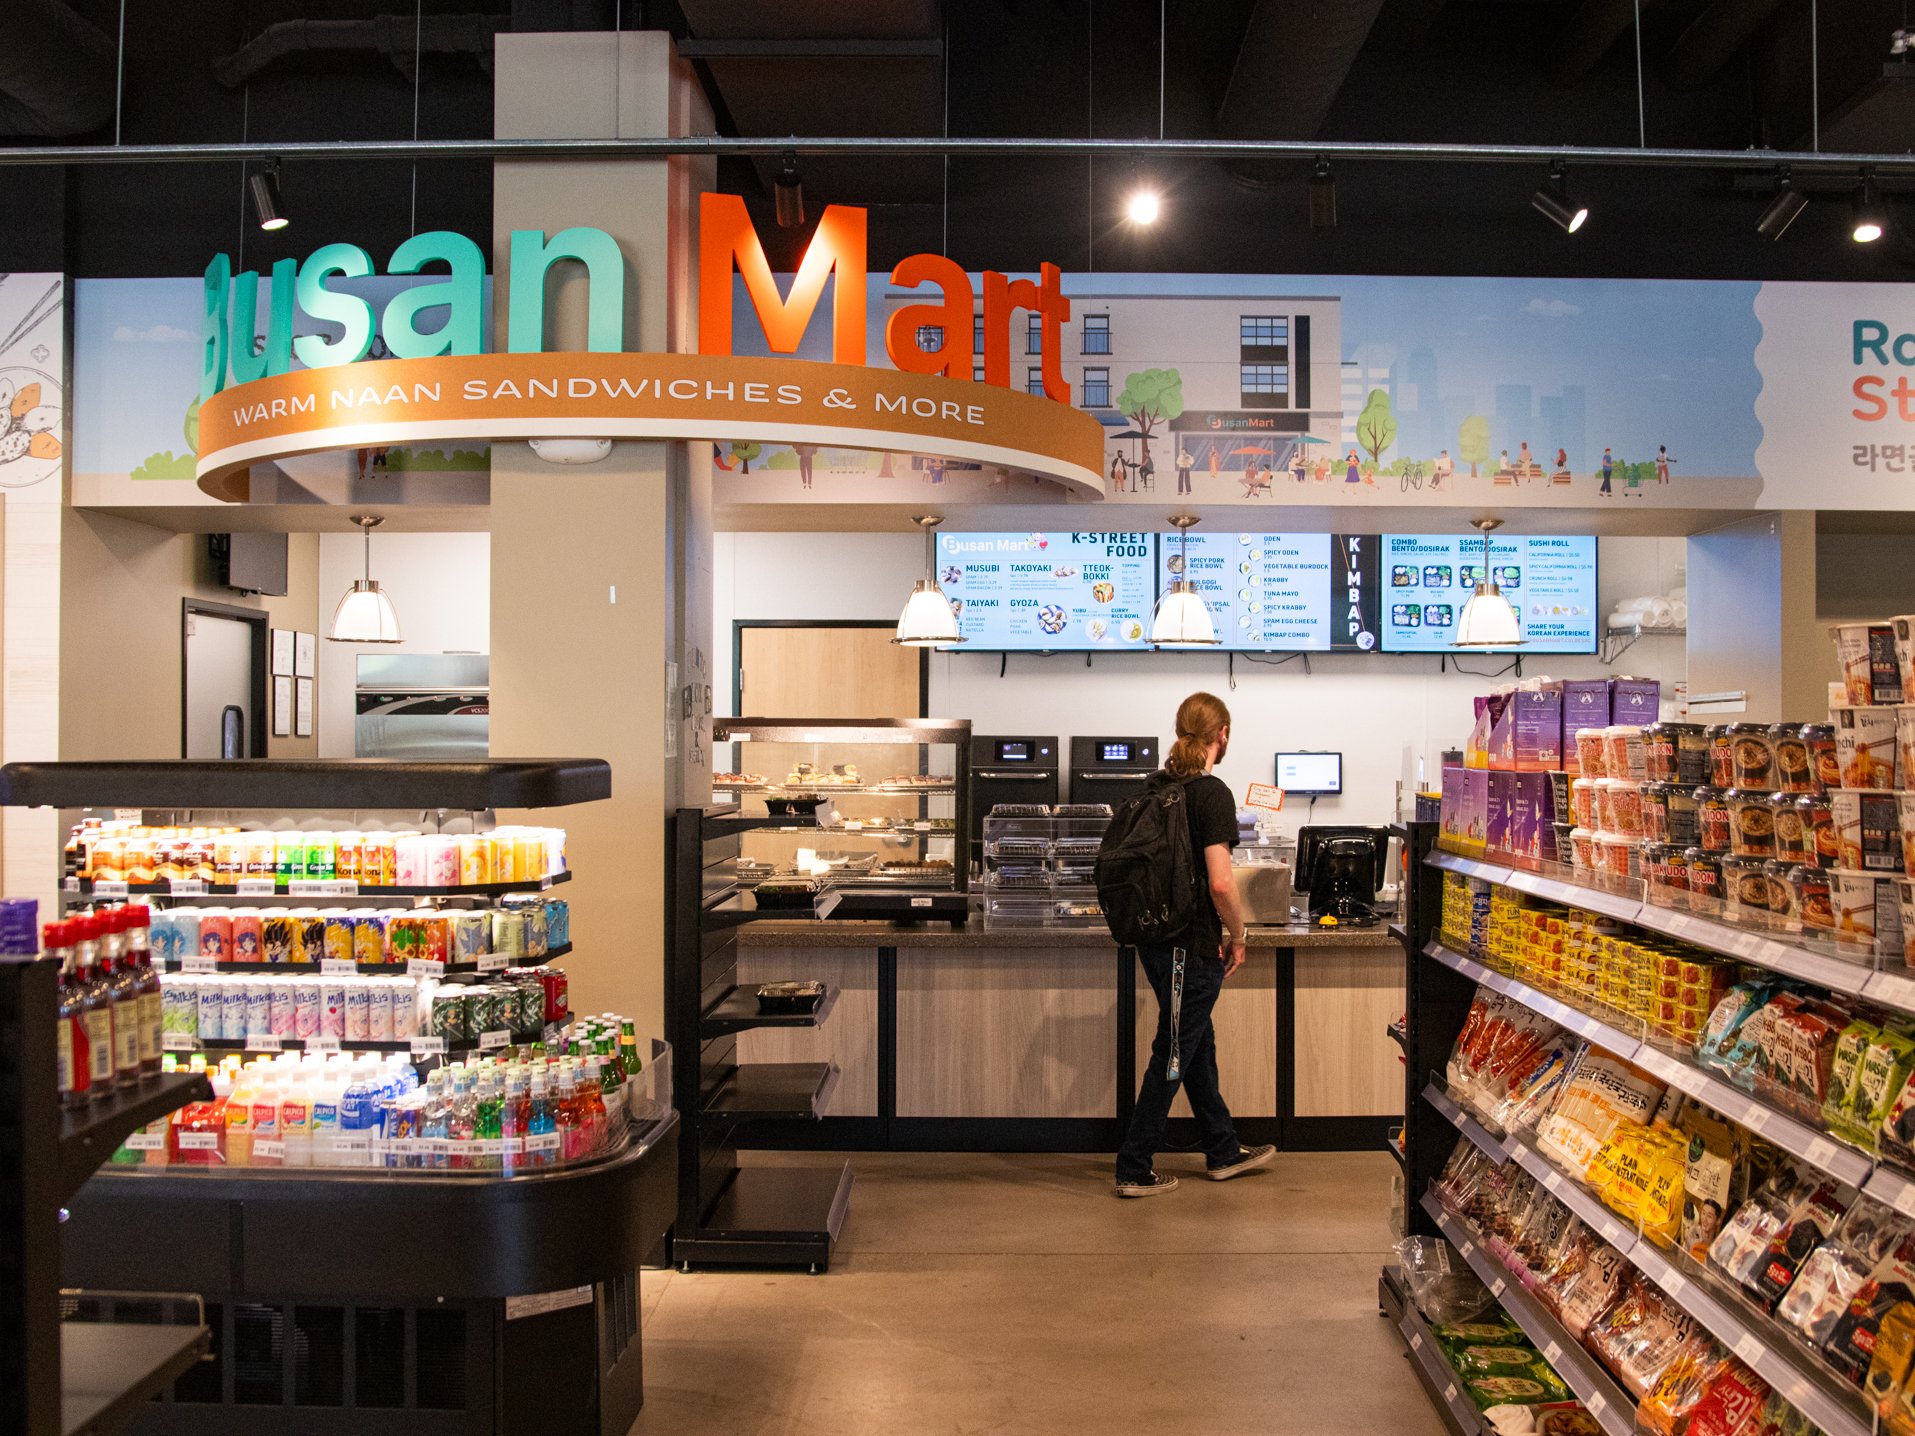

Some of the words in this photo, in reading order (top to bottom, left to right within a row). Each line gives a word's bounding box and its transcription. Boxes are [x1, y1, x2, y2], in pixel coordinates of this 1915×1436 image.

[200, 226, 625, 400] Busan
[698, 191, 1072, 405] Mart
[233, 392, 318, 427] WARM
[329, 382, 442, 410] NAAN
[463, 377, 803, 406] SANDWICHES
[822, 387, 858, 411] &
[874, 391, 986, 425] MORE
[1072, 532, 1148, 544] K-STREET
[1391, 538, 1418, 546] COMBO
[997, 538, 1030, 552] Mart
[1391, 545, 1450, 553] BENTO/DOSIRAK
[1107, 546, 1147, 557] FOOD
[966, 564, 1000, 572] MUSUBI
[1010, 564, 1052, 572] TAKOYAKI
[1083, 572, 1110, 581] BOKKI
[1347, 537, 1361, 637] KIMBAP
[966, 599, 999, 607] TAIYAKI
[1010, 599, 1039, 607] GYOZA
[283, 1107, 304, 1115] CALPICO
[314, 1106, 335, 1115] CALPICO
[1620, 1154, 1639, 1171] PLAIN
